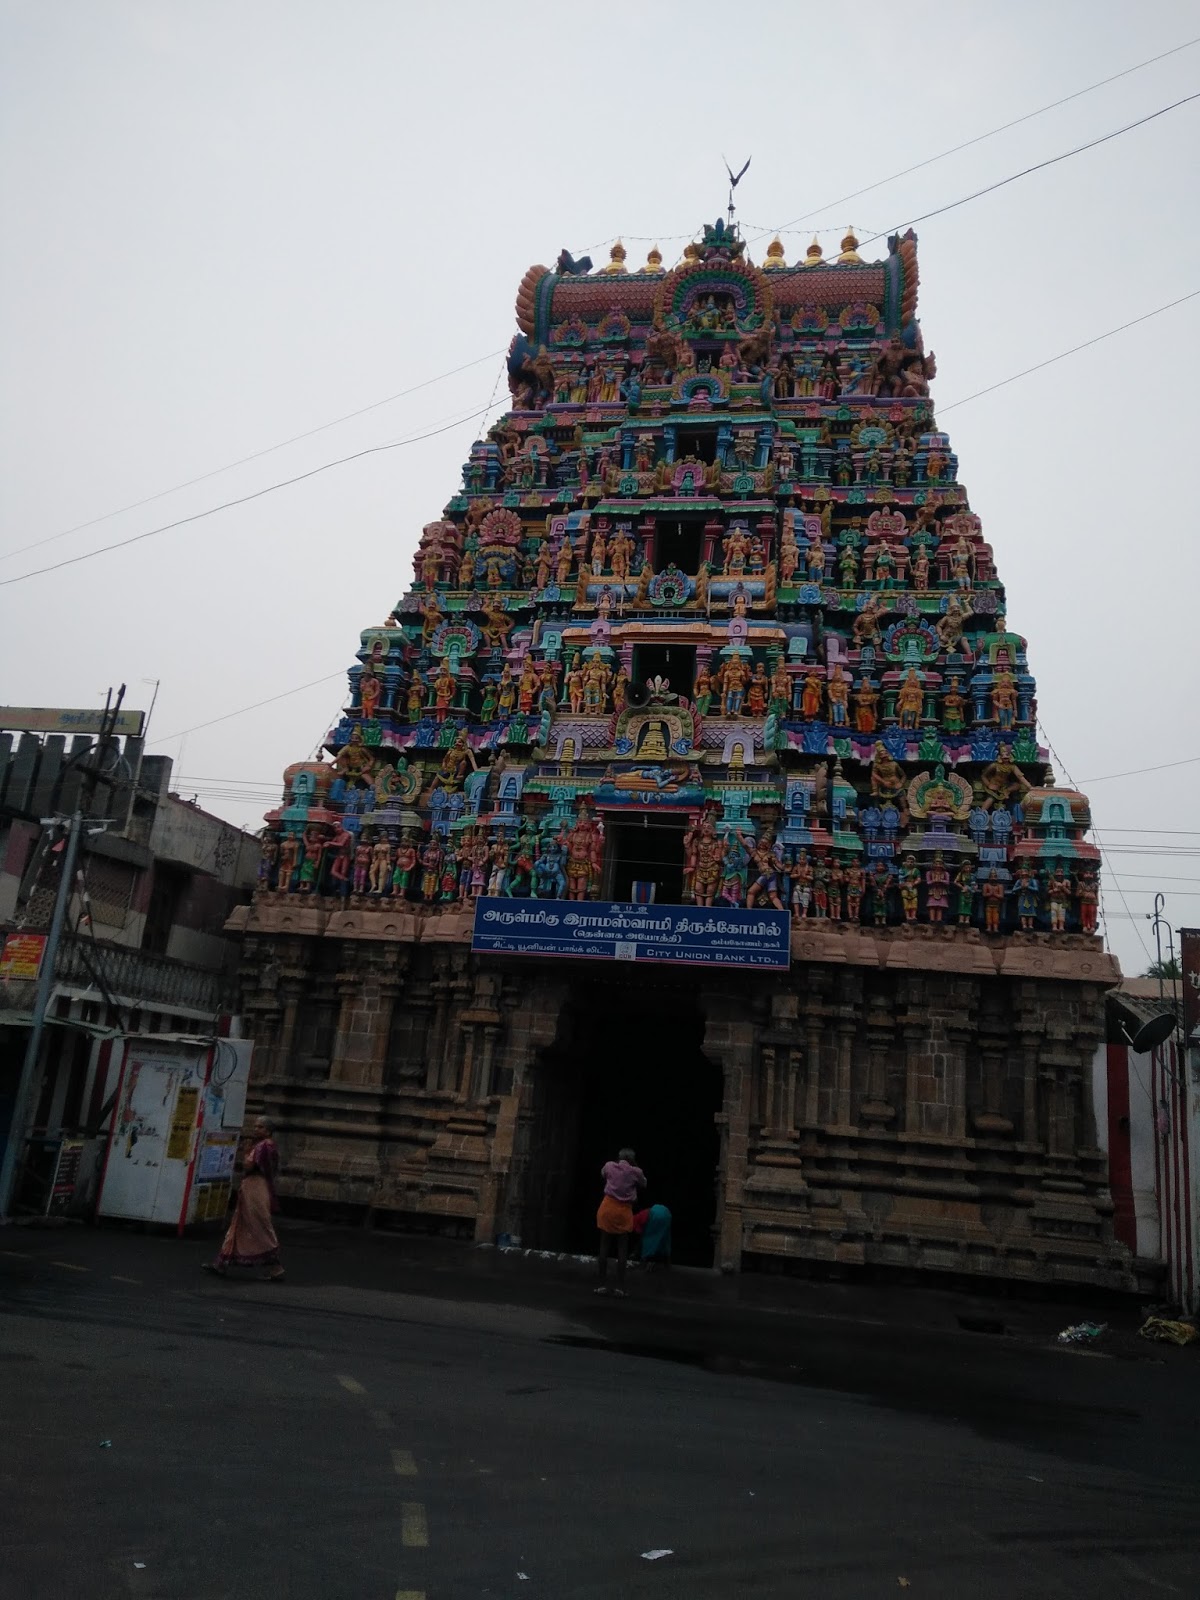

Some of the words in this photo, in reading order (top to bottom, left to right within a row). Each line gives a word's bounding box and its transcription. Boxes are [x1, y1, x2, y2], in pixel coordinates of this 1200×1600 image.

[482, 908, 560, 927] அருள்மிகு
[563, 912, 672, 931] இராமஸ்வாமி
[674, 917, 782, 937] திருக்கோயில்
[517, 941, 556, 953] யூனியன்
